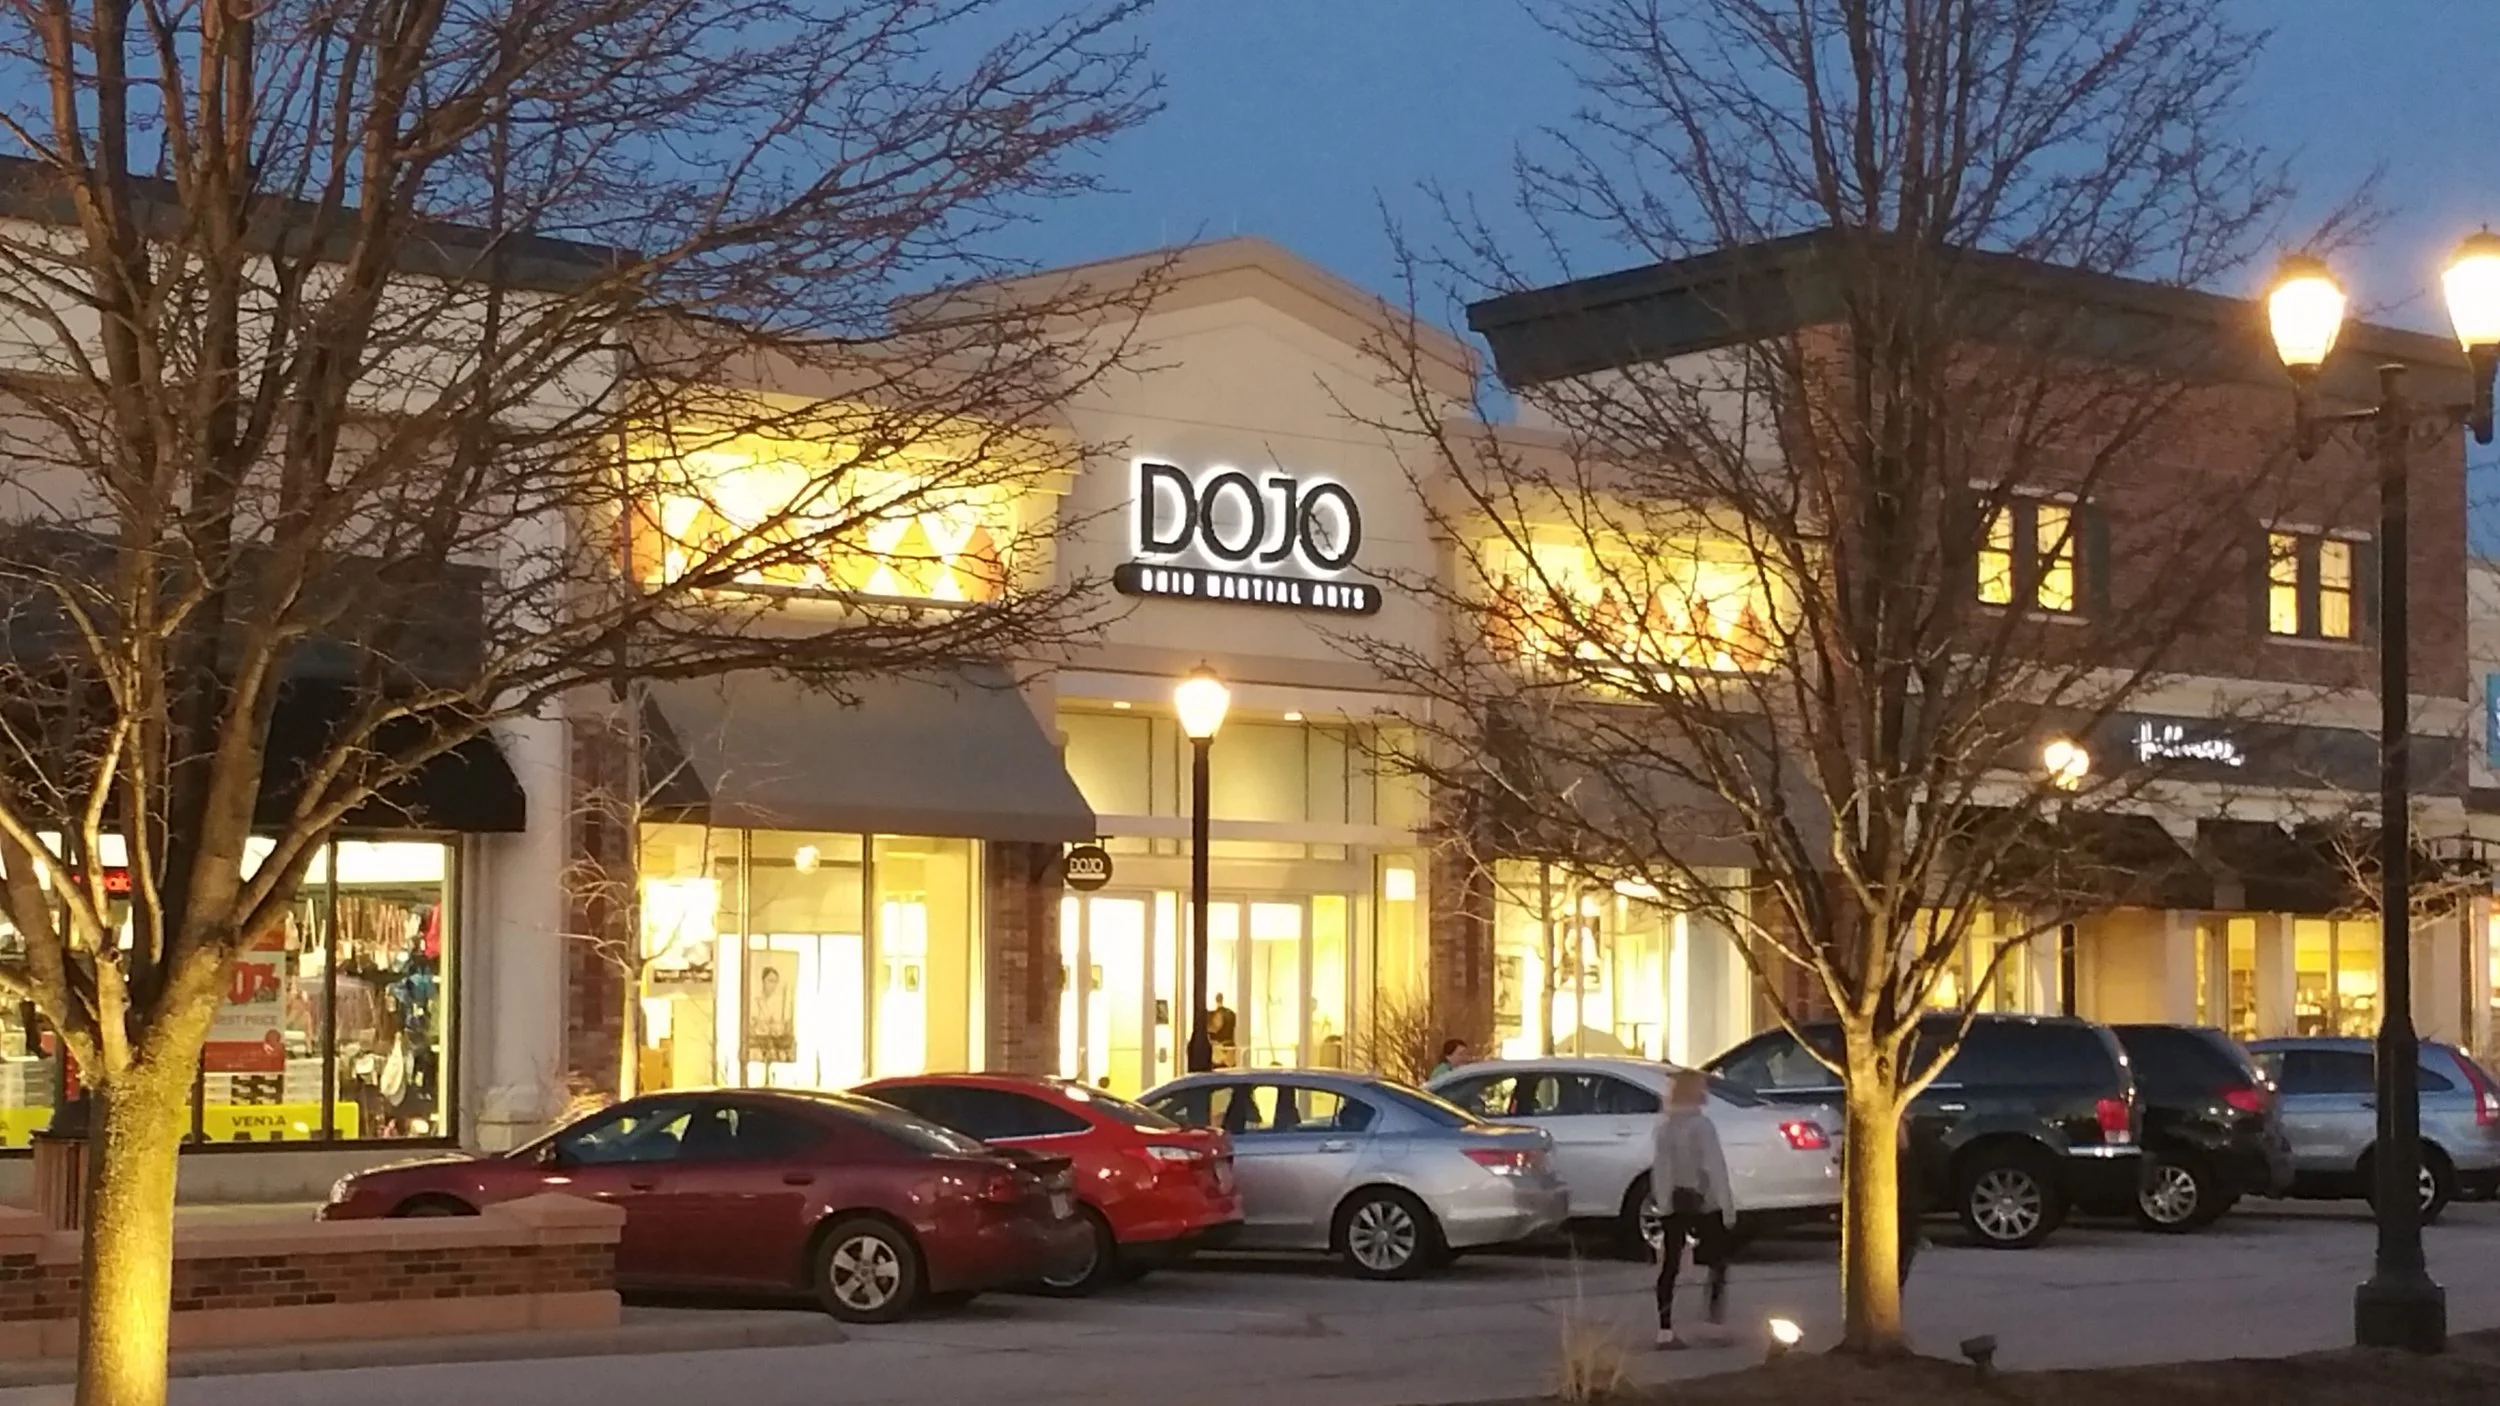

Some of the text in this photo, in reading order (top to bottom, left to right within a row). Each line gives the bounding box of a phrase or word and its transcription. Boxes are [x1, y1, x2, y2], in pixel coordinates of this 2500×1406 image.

[1141, 463, 1361, 571] DOJO
[1206, 574, 1302, 605] MARTIAL
[1311, 584, 1366, 610] ARTS
[1069, 857, 1104, 873] DOJO
